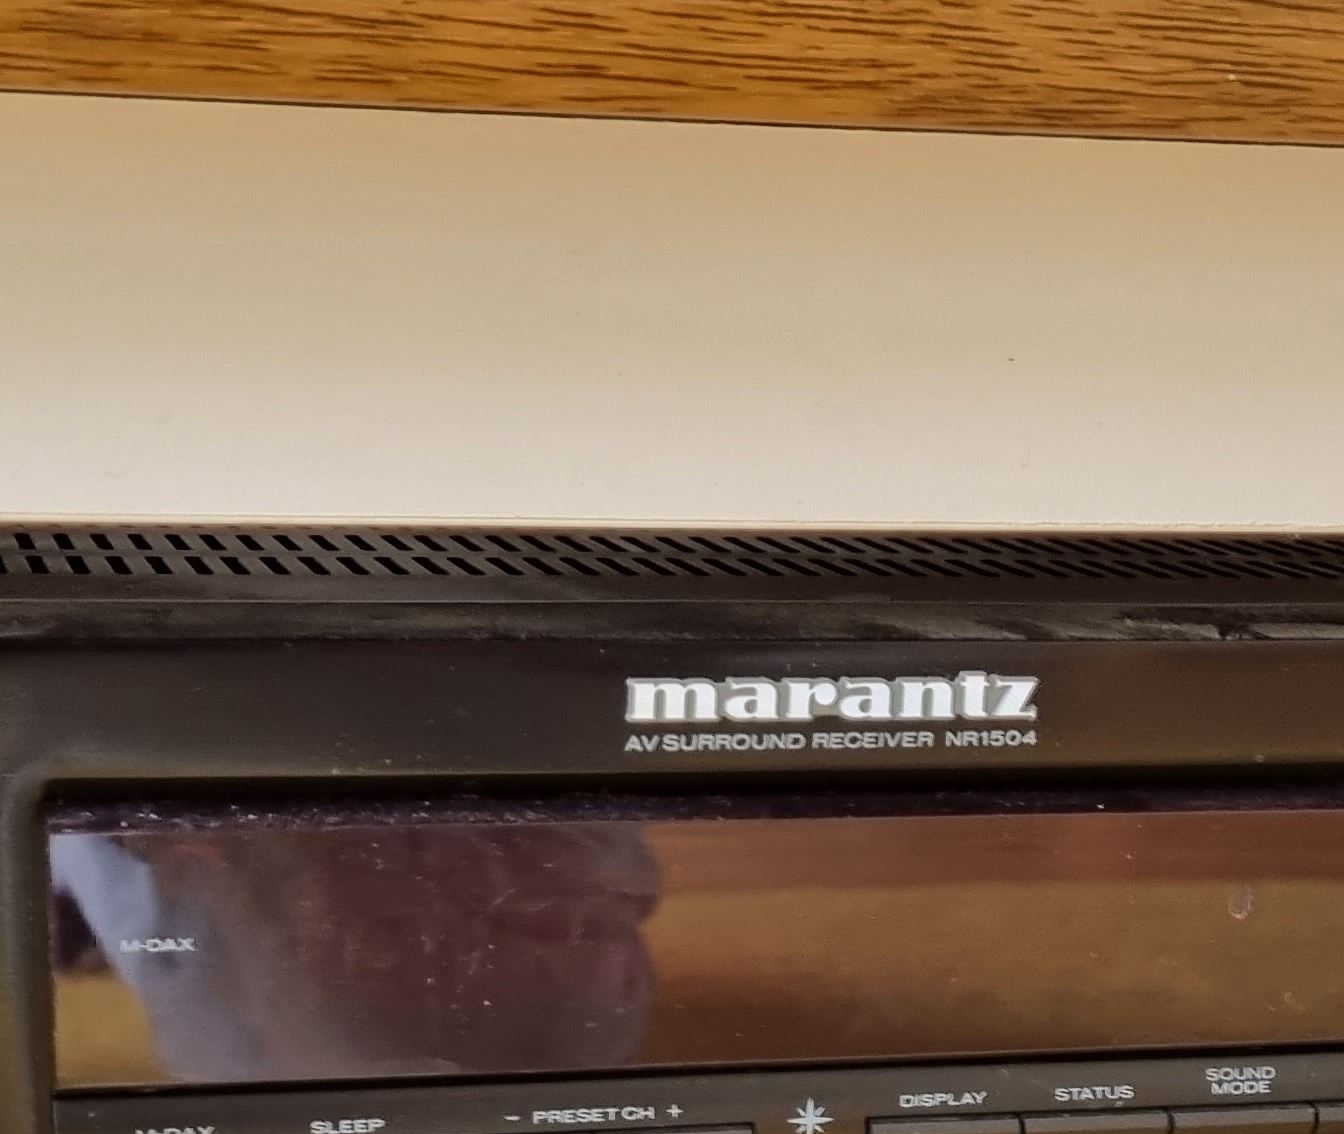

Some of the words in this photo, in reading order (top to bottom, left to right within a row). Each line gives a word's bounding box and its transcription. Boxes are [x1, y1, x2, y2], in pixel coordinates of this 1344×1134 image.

[625, 670, 1039, 722] marantz
[662, 733, 806, 751] SURROUND
[811, 732, 933, 749] RECEIVER
[945, 730, 1037, 747] NR1504
[119, 936, 197, 954] M-DAX
[1205, 1065, 1276, 1082] SOUND
[1055, 1085, 1134, 1103] STATUS
[1211, 1079, 1272, 1096] MODE
[900, 1090, 987, 1108] DISPLAY
[532, 1107, 620, 1125] PRESET
